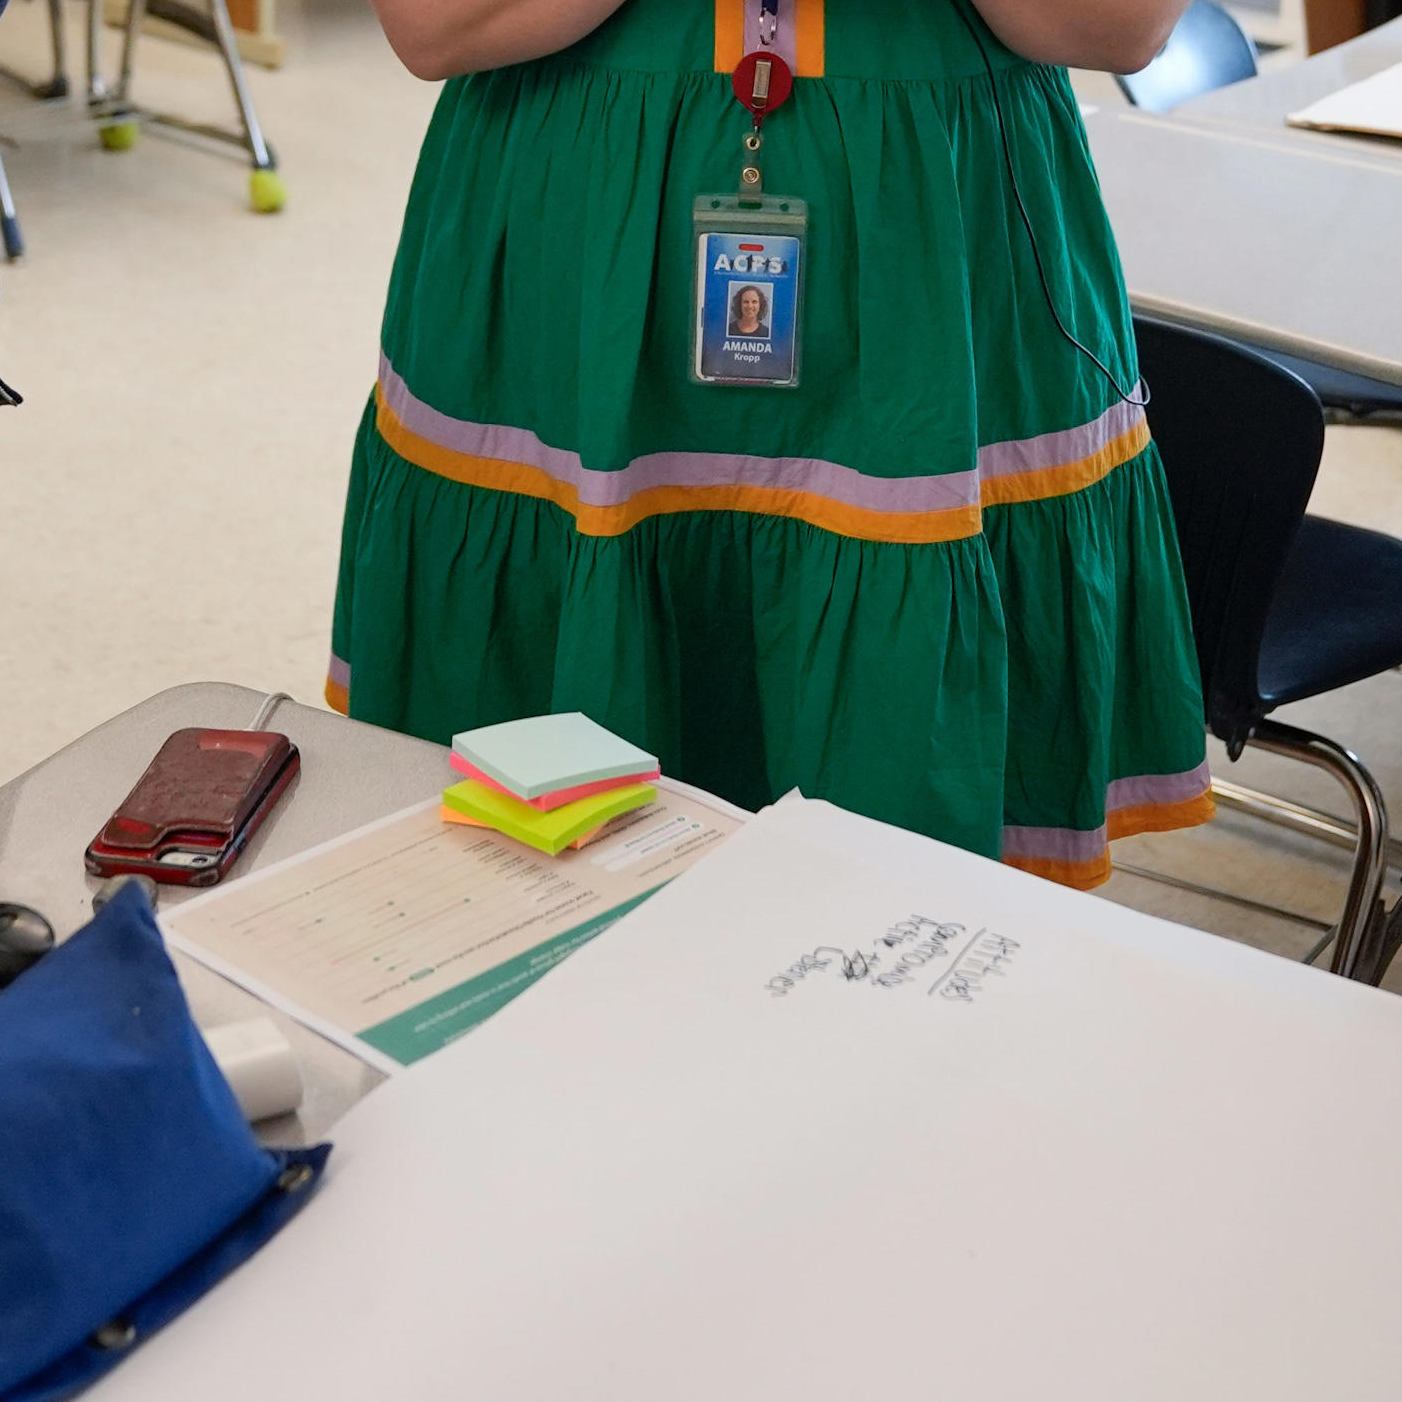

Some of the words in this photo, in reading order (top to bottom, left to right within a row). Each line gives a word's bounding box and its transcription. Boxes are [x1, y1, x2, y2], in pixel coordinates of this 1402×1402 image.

[714, 253, 783, 274] ACPS
[722, 340, 773, 354] AMANDA
[733, 353, 761, 364] Kropp
